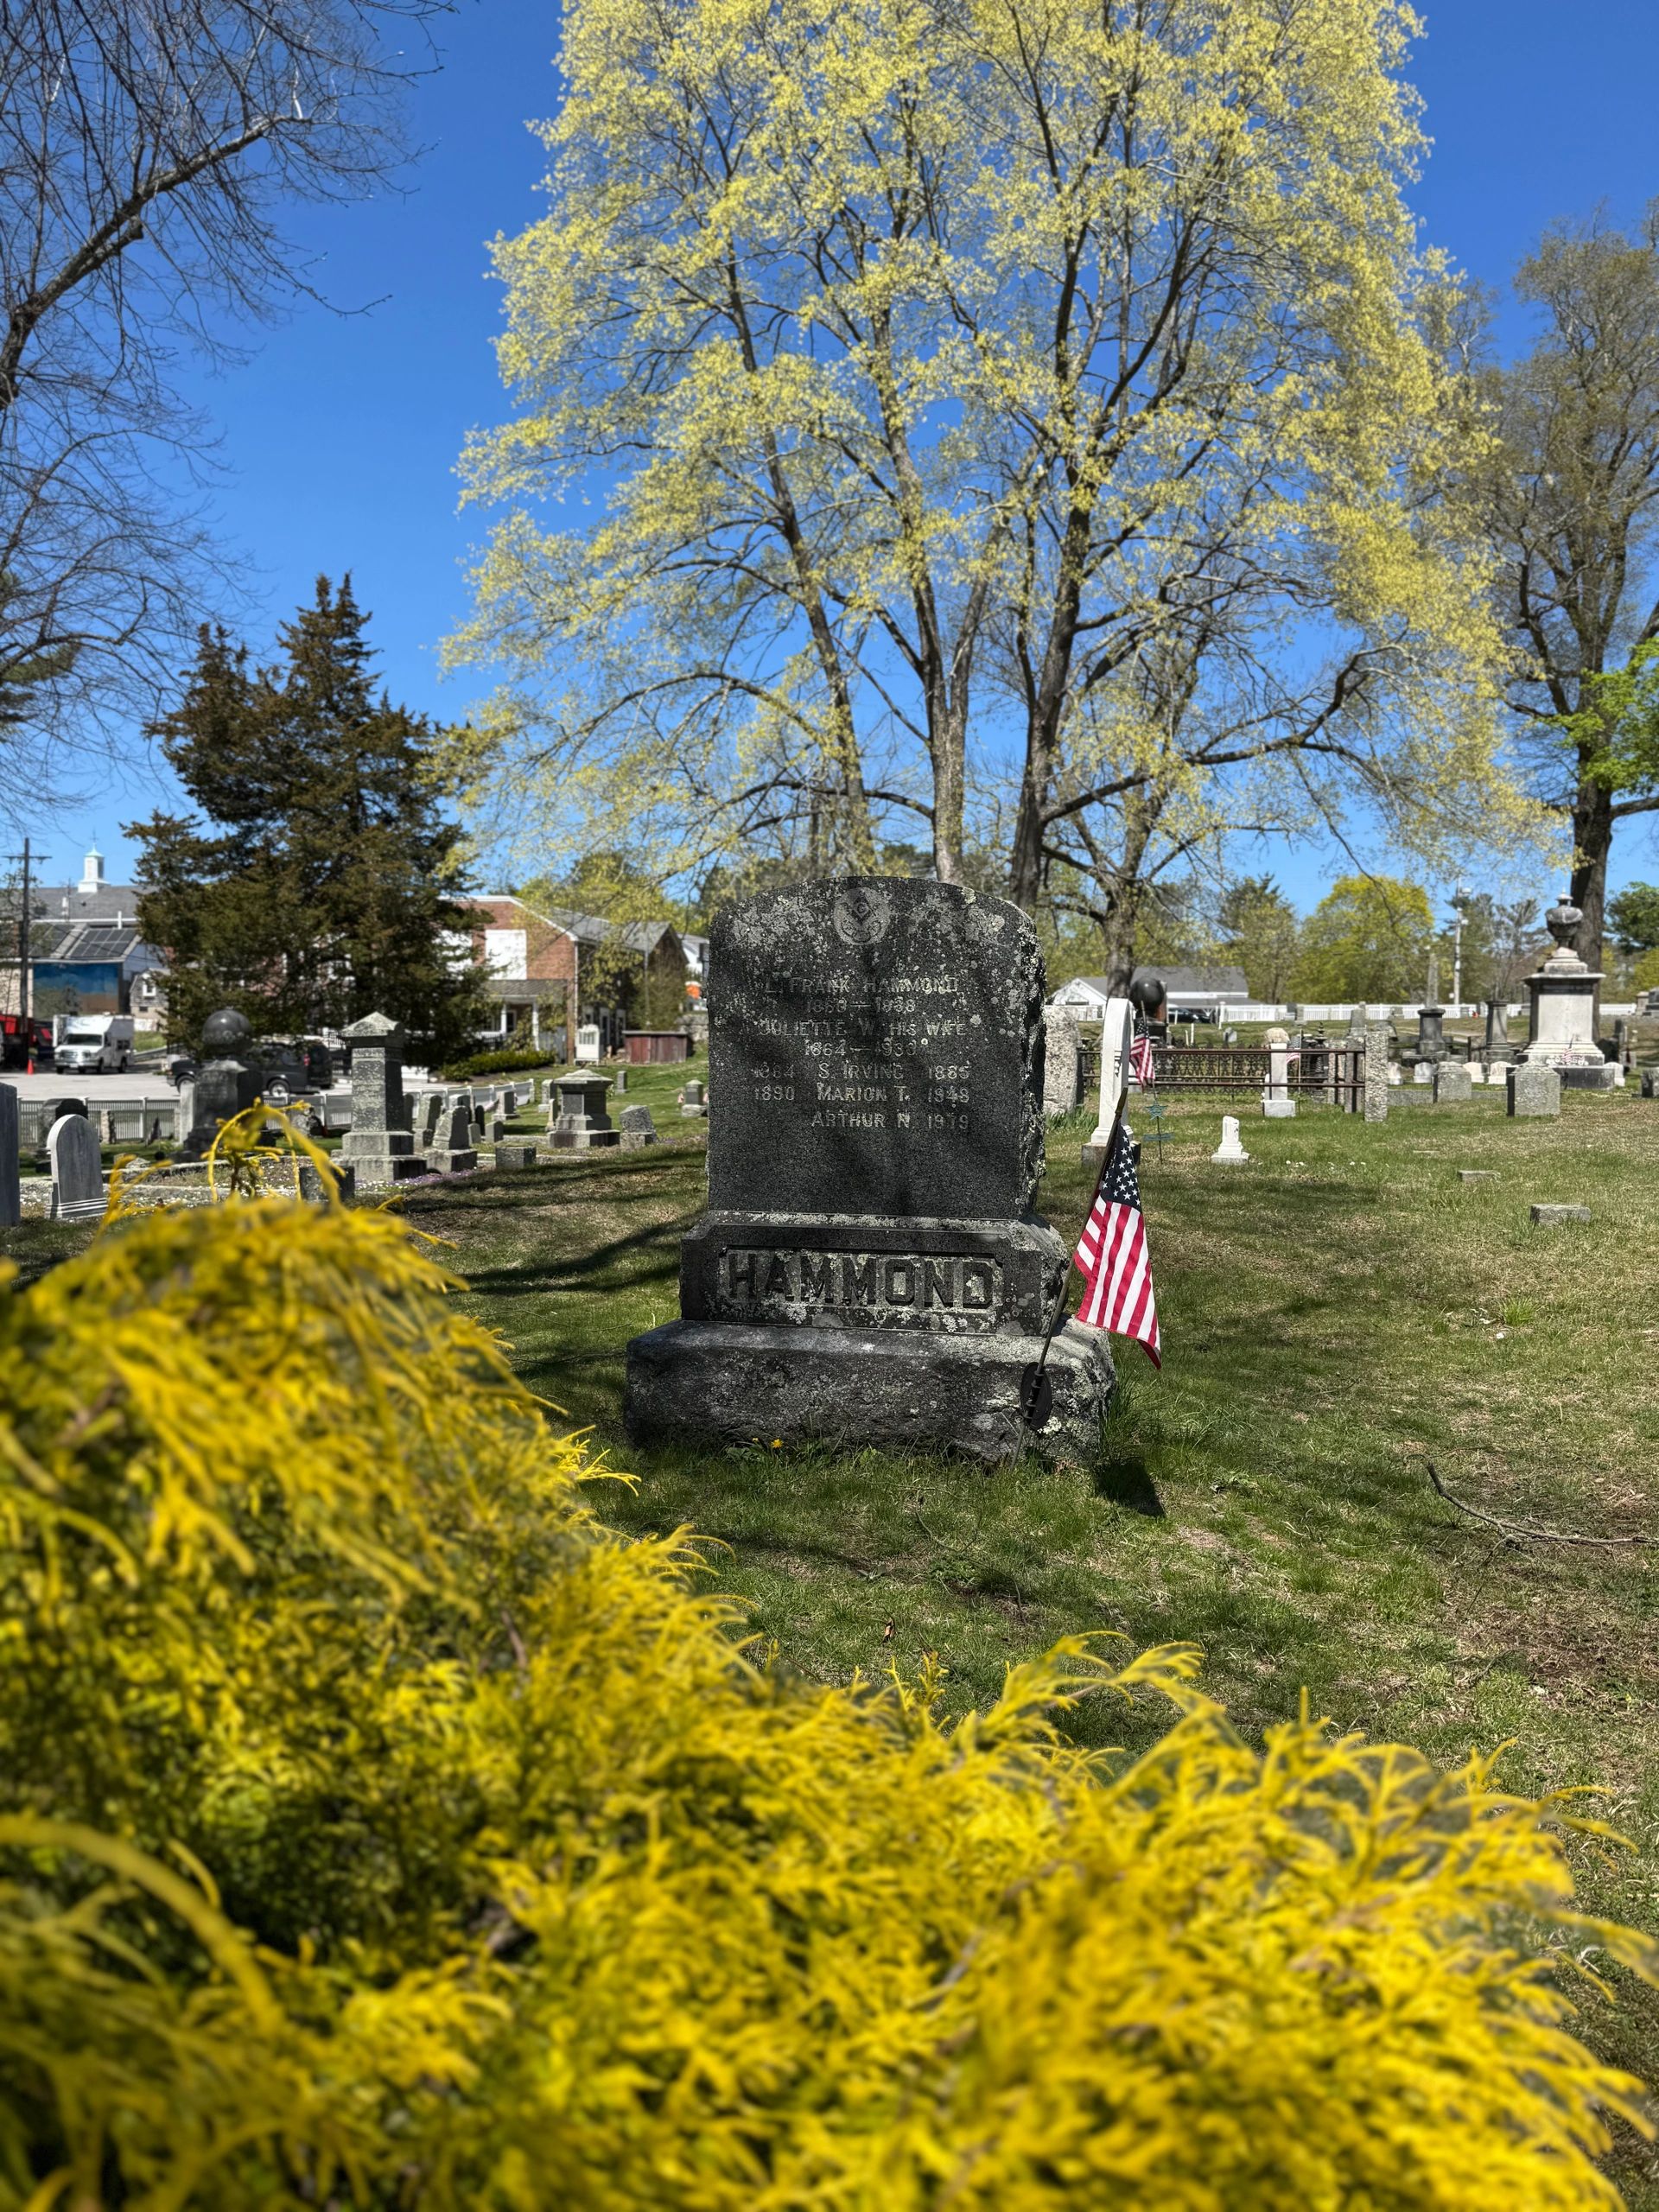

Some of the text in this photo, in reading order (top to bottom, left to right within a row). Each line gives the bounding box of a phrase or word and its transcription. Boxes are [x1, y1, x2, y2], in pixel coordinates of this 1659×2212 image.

[789, 977, 850, 993] FRANK
[863, 976, 959, 994] HAMMOND
[758, 1018, 847, 1035] JULIETTE
[889, 1020, 917, 1035] HIS
[926, 1020, 966, 1035] WIFE
[805, 1041, 847, 1056] 1864
[842, 1063, 905, 1080] IRVING
[753, 1086, 795, 1101] 1890
[816, 1084, 887, 1102] MARION
[811, 1111, 887, 1128] ARTHUR
[728, 1251, 995, 1309] HAMMOND
